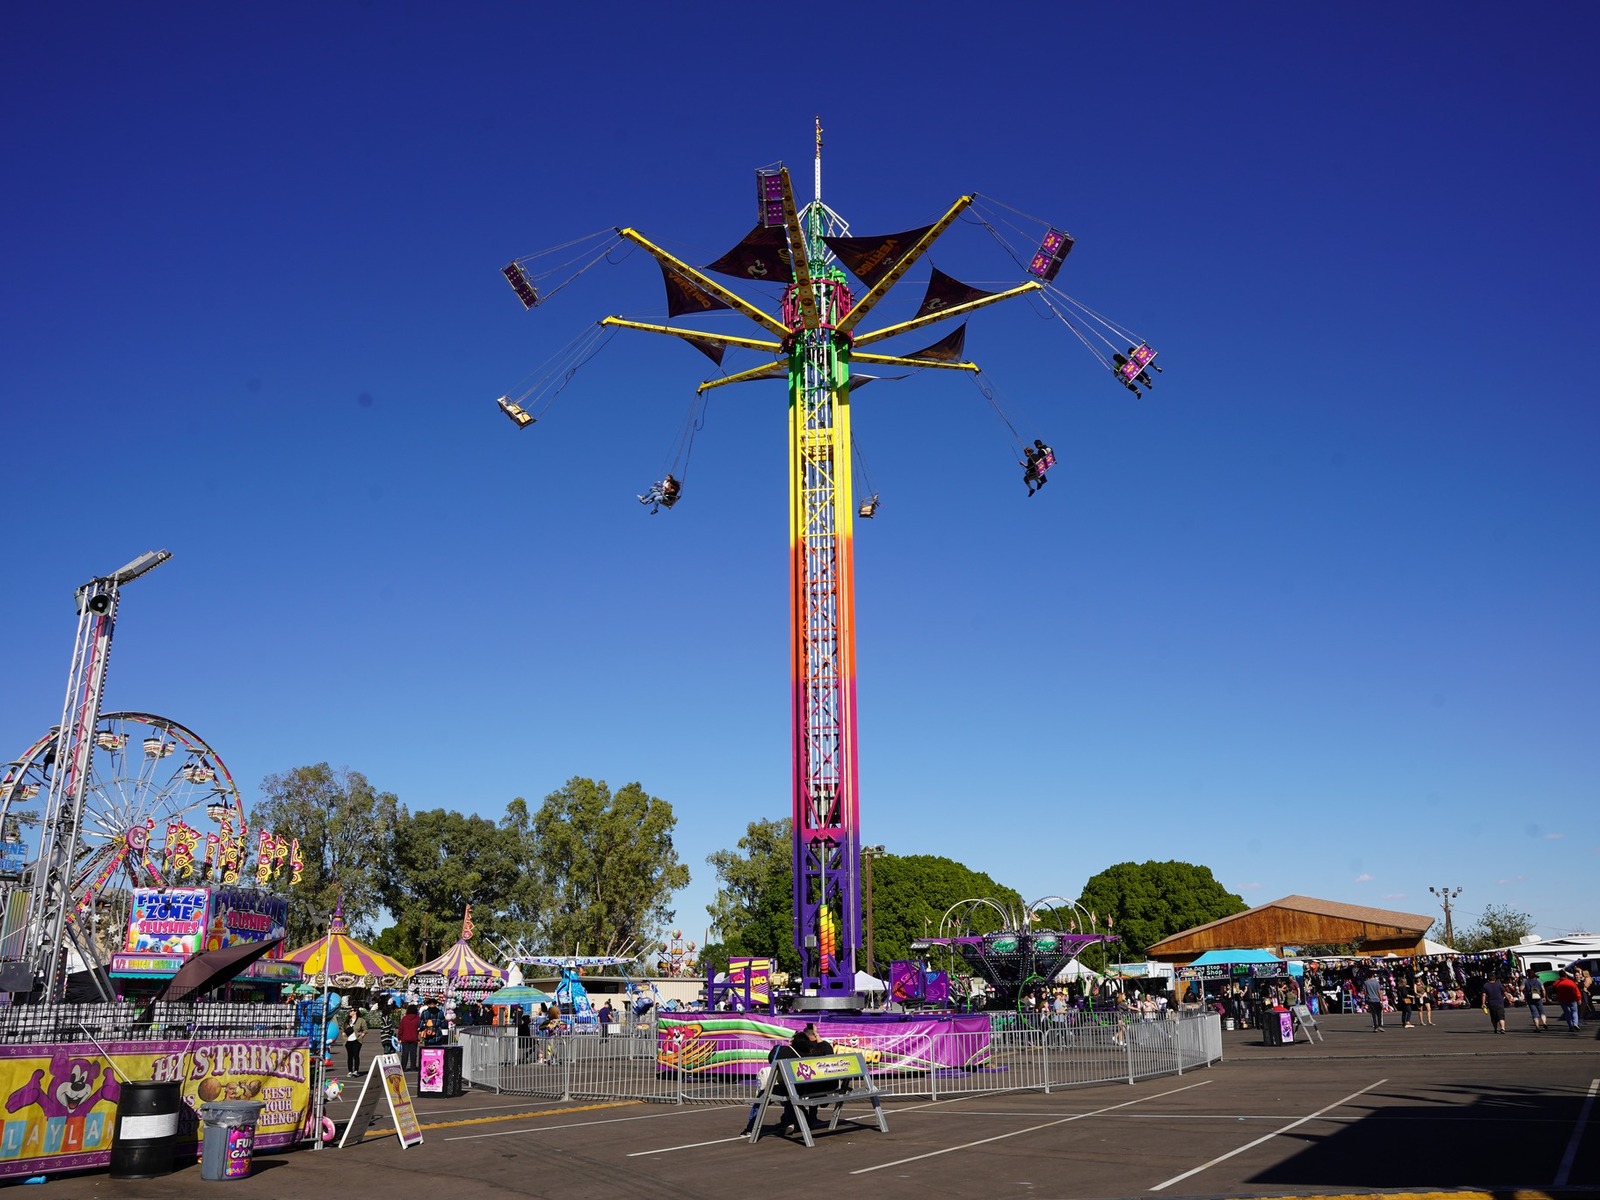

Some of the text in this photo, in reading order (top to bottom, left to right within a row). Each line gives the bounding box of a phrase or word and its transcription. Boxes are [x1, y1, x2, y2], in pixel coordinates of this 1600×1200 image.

[137, 891, 207, 908] FREEZE
[145, 904, 194, 921] ZONE
[214, 891, 285, 926] FREEZE ZONE
[138, 920, 200, 935] SLUSHIES
[227, 911, 272, 933] SLUSHIES
[152, 1043, 306, 1082] HI STRIKER
[261, 1086, 293, 1100] TEST
[264, 1099, 293, 1113] YOUR
[7, 1119, 114, 1150] LAYLAN
